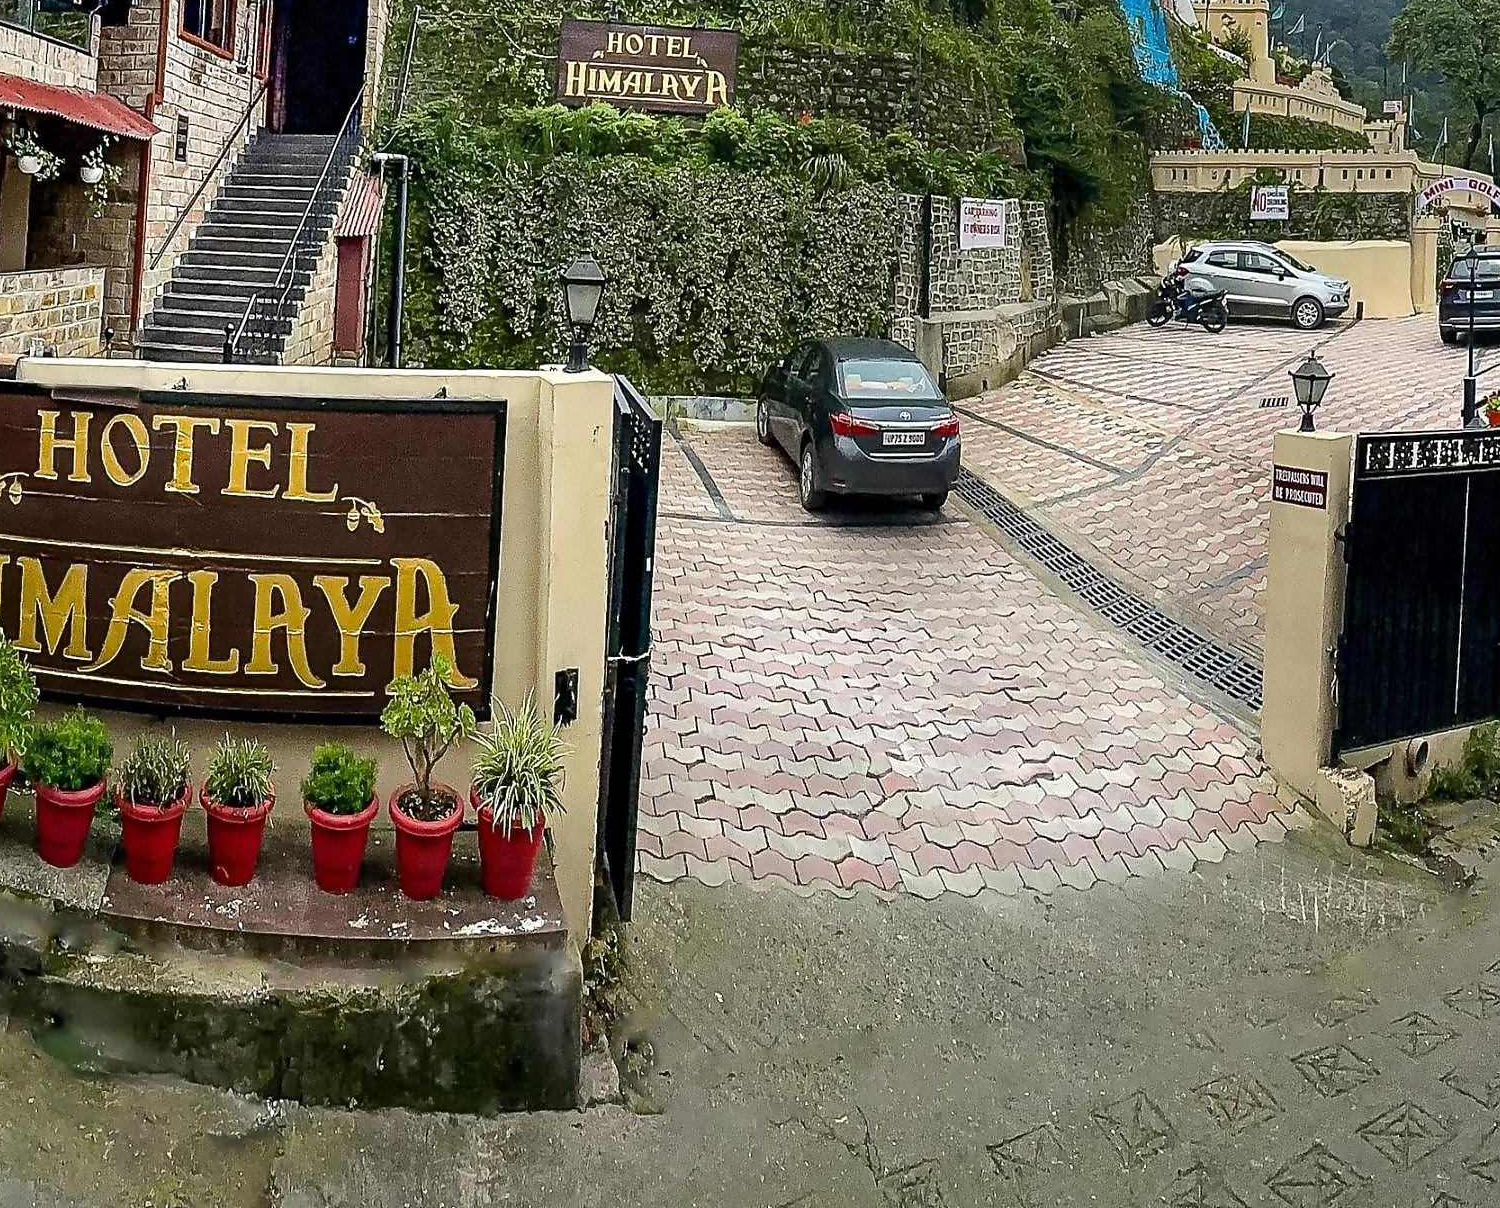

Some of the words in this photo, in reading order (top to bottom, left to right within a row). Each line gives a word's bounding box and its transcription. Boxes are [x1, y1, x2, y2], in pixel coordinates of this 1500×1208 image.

[606, 31, 699, 59] HOTEL
[564, 60, 730, 107] HIMALAYA
[1423, 179, 1454, 200] MINI
[1253, 191, 1267, 212] NO
[34, 409, 339, 503] HOTEL
[1275, 468, 1310, 485] TRESPASSERS
[1275, 485, 1284, 499] BE
[1285, 487, 1324, 506] PROSECUTED
